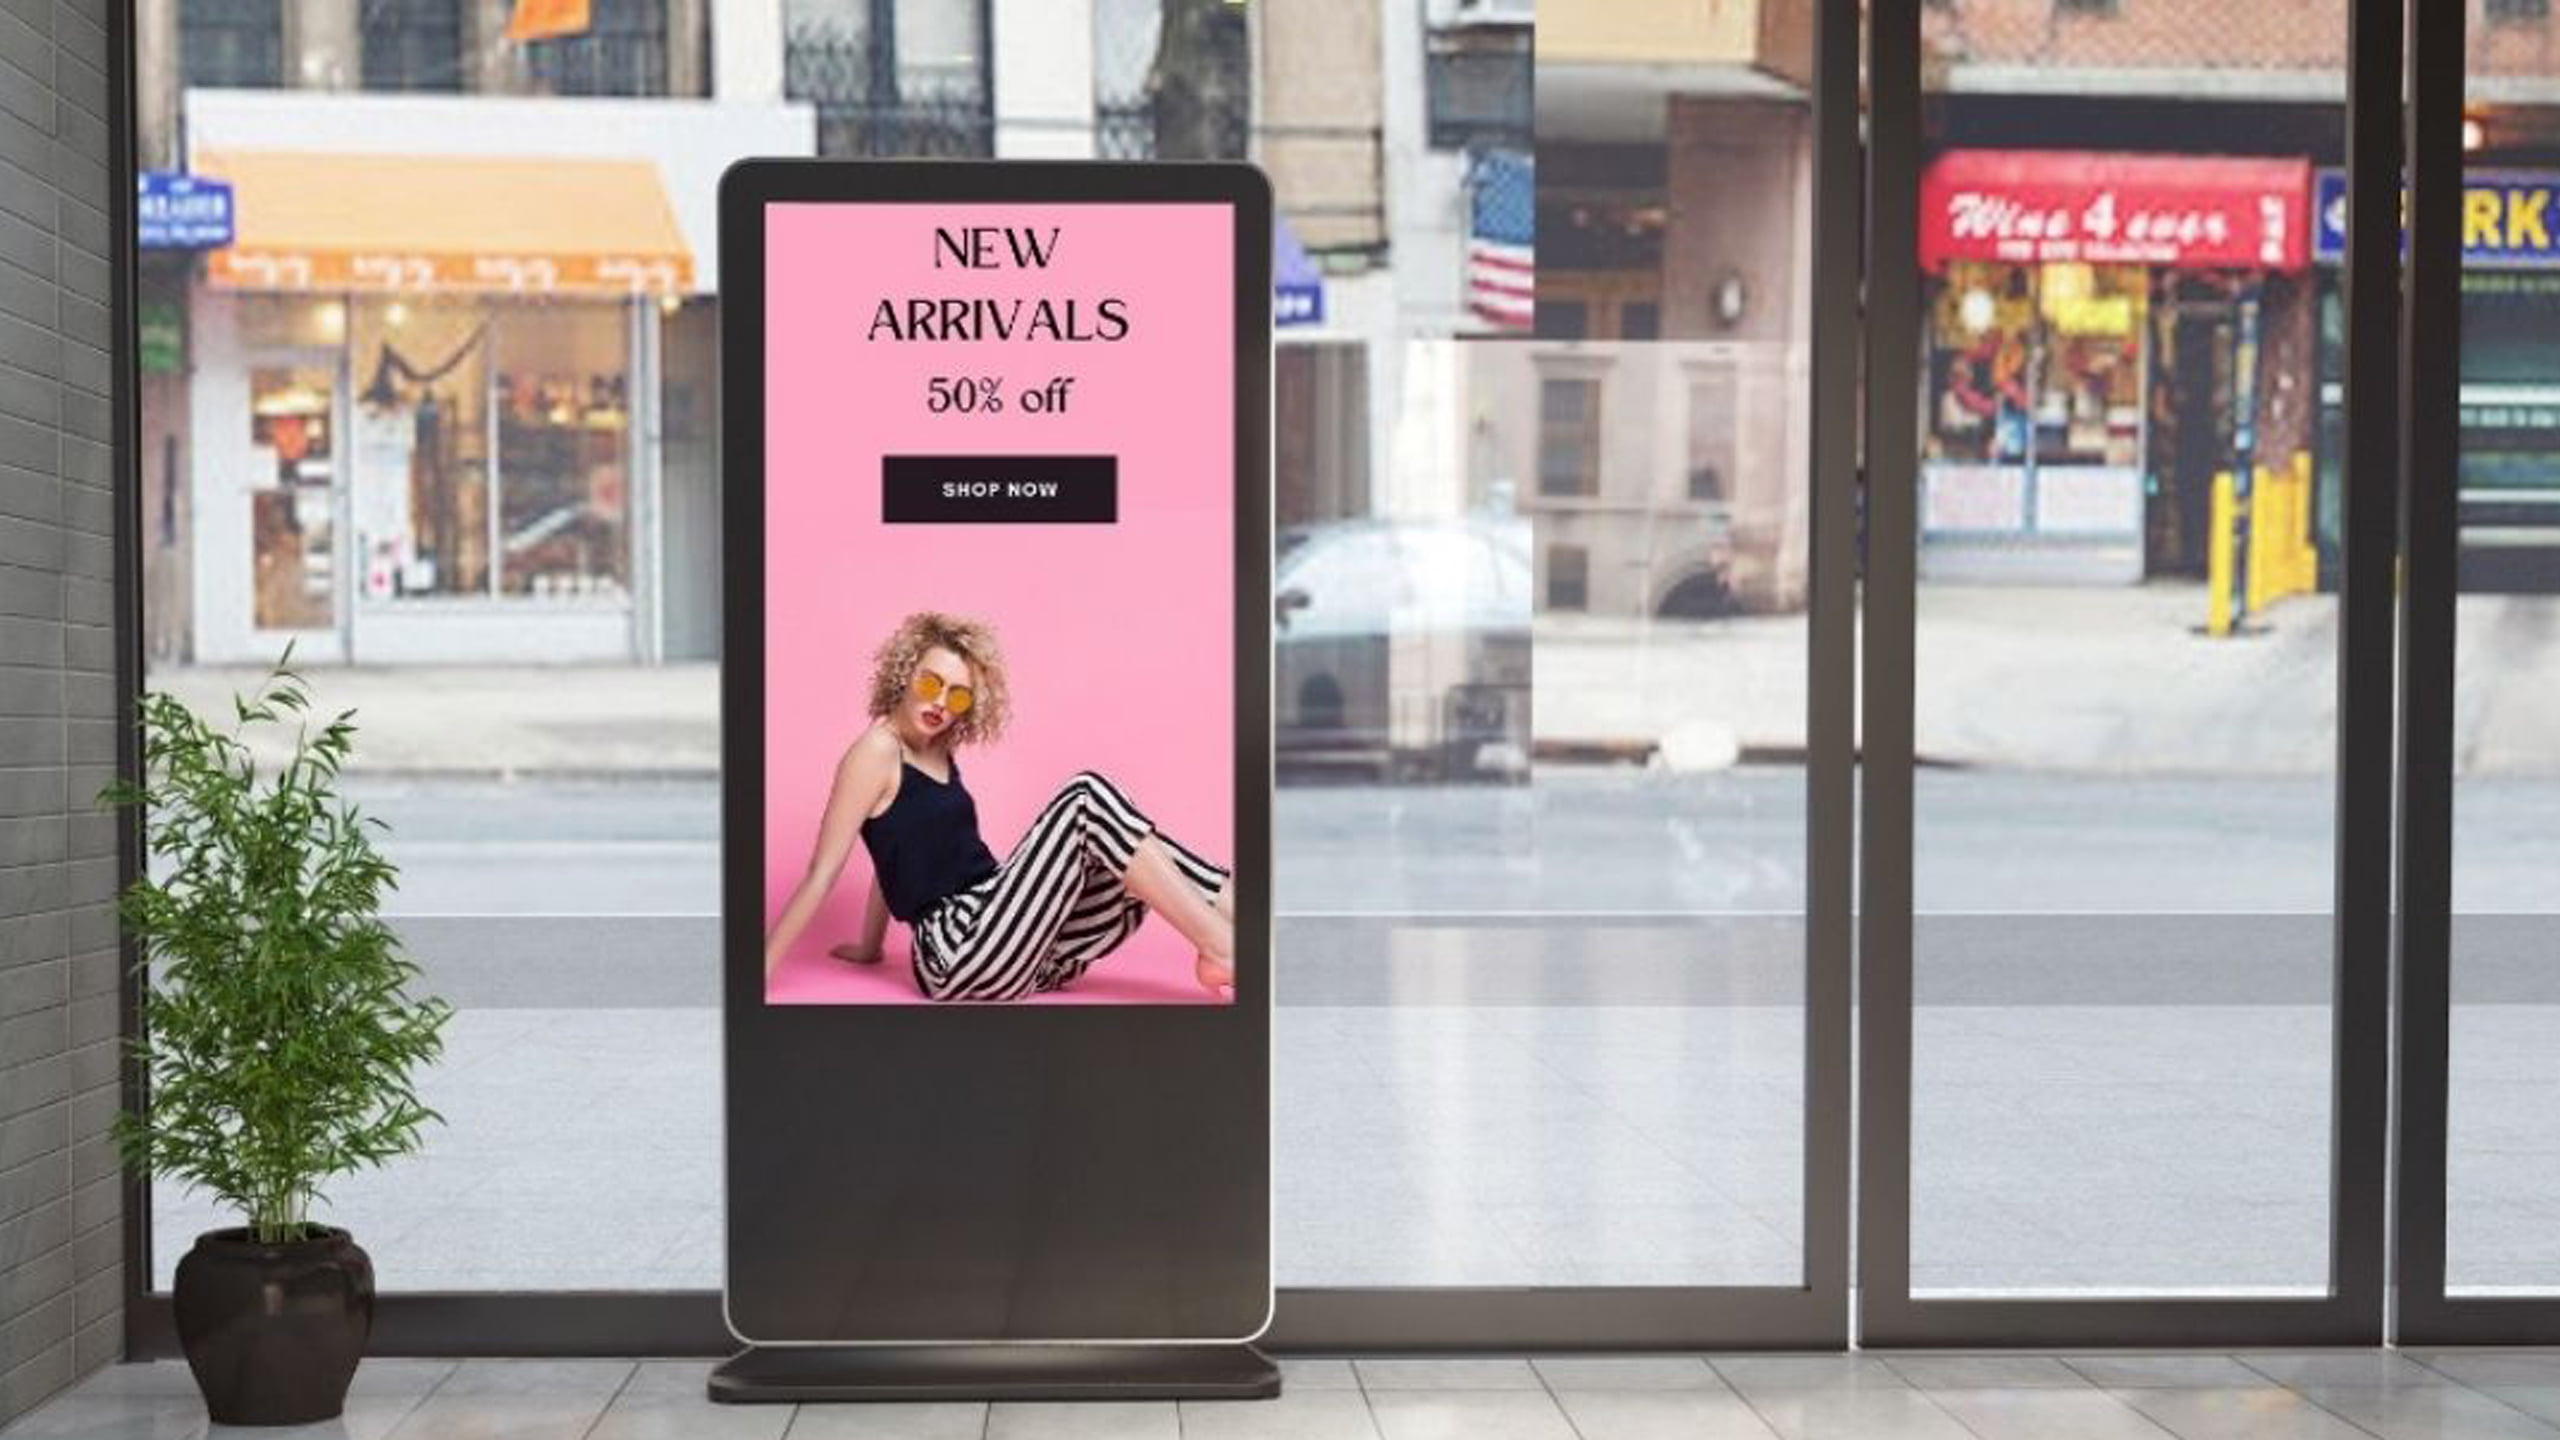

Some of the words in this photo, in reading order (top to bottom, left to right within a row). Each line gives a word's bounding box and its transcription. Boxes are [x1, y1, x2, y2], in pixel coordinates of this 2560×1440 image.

[1949, 192, 2071, 239] Wine
[2081, 191, 2118, 241] 4
[2125, 209, 2228, 246] ever
[2462, 188, 2550, 248] RK
[934, 226, 1061, 269] NEW
[867, 298, 1130, 342] ARRIVALS
[926, 376, 1004, 414] 50%
[1019, 376, 1075, 414] off
[941, 481, 1001, 498] SHOP
[1007, 481, 1059, 498] NOW
